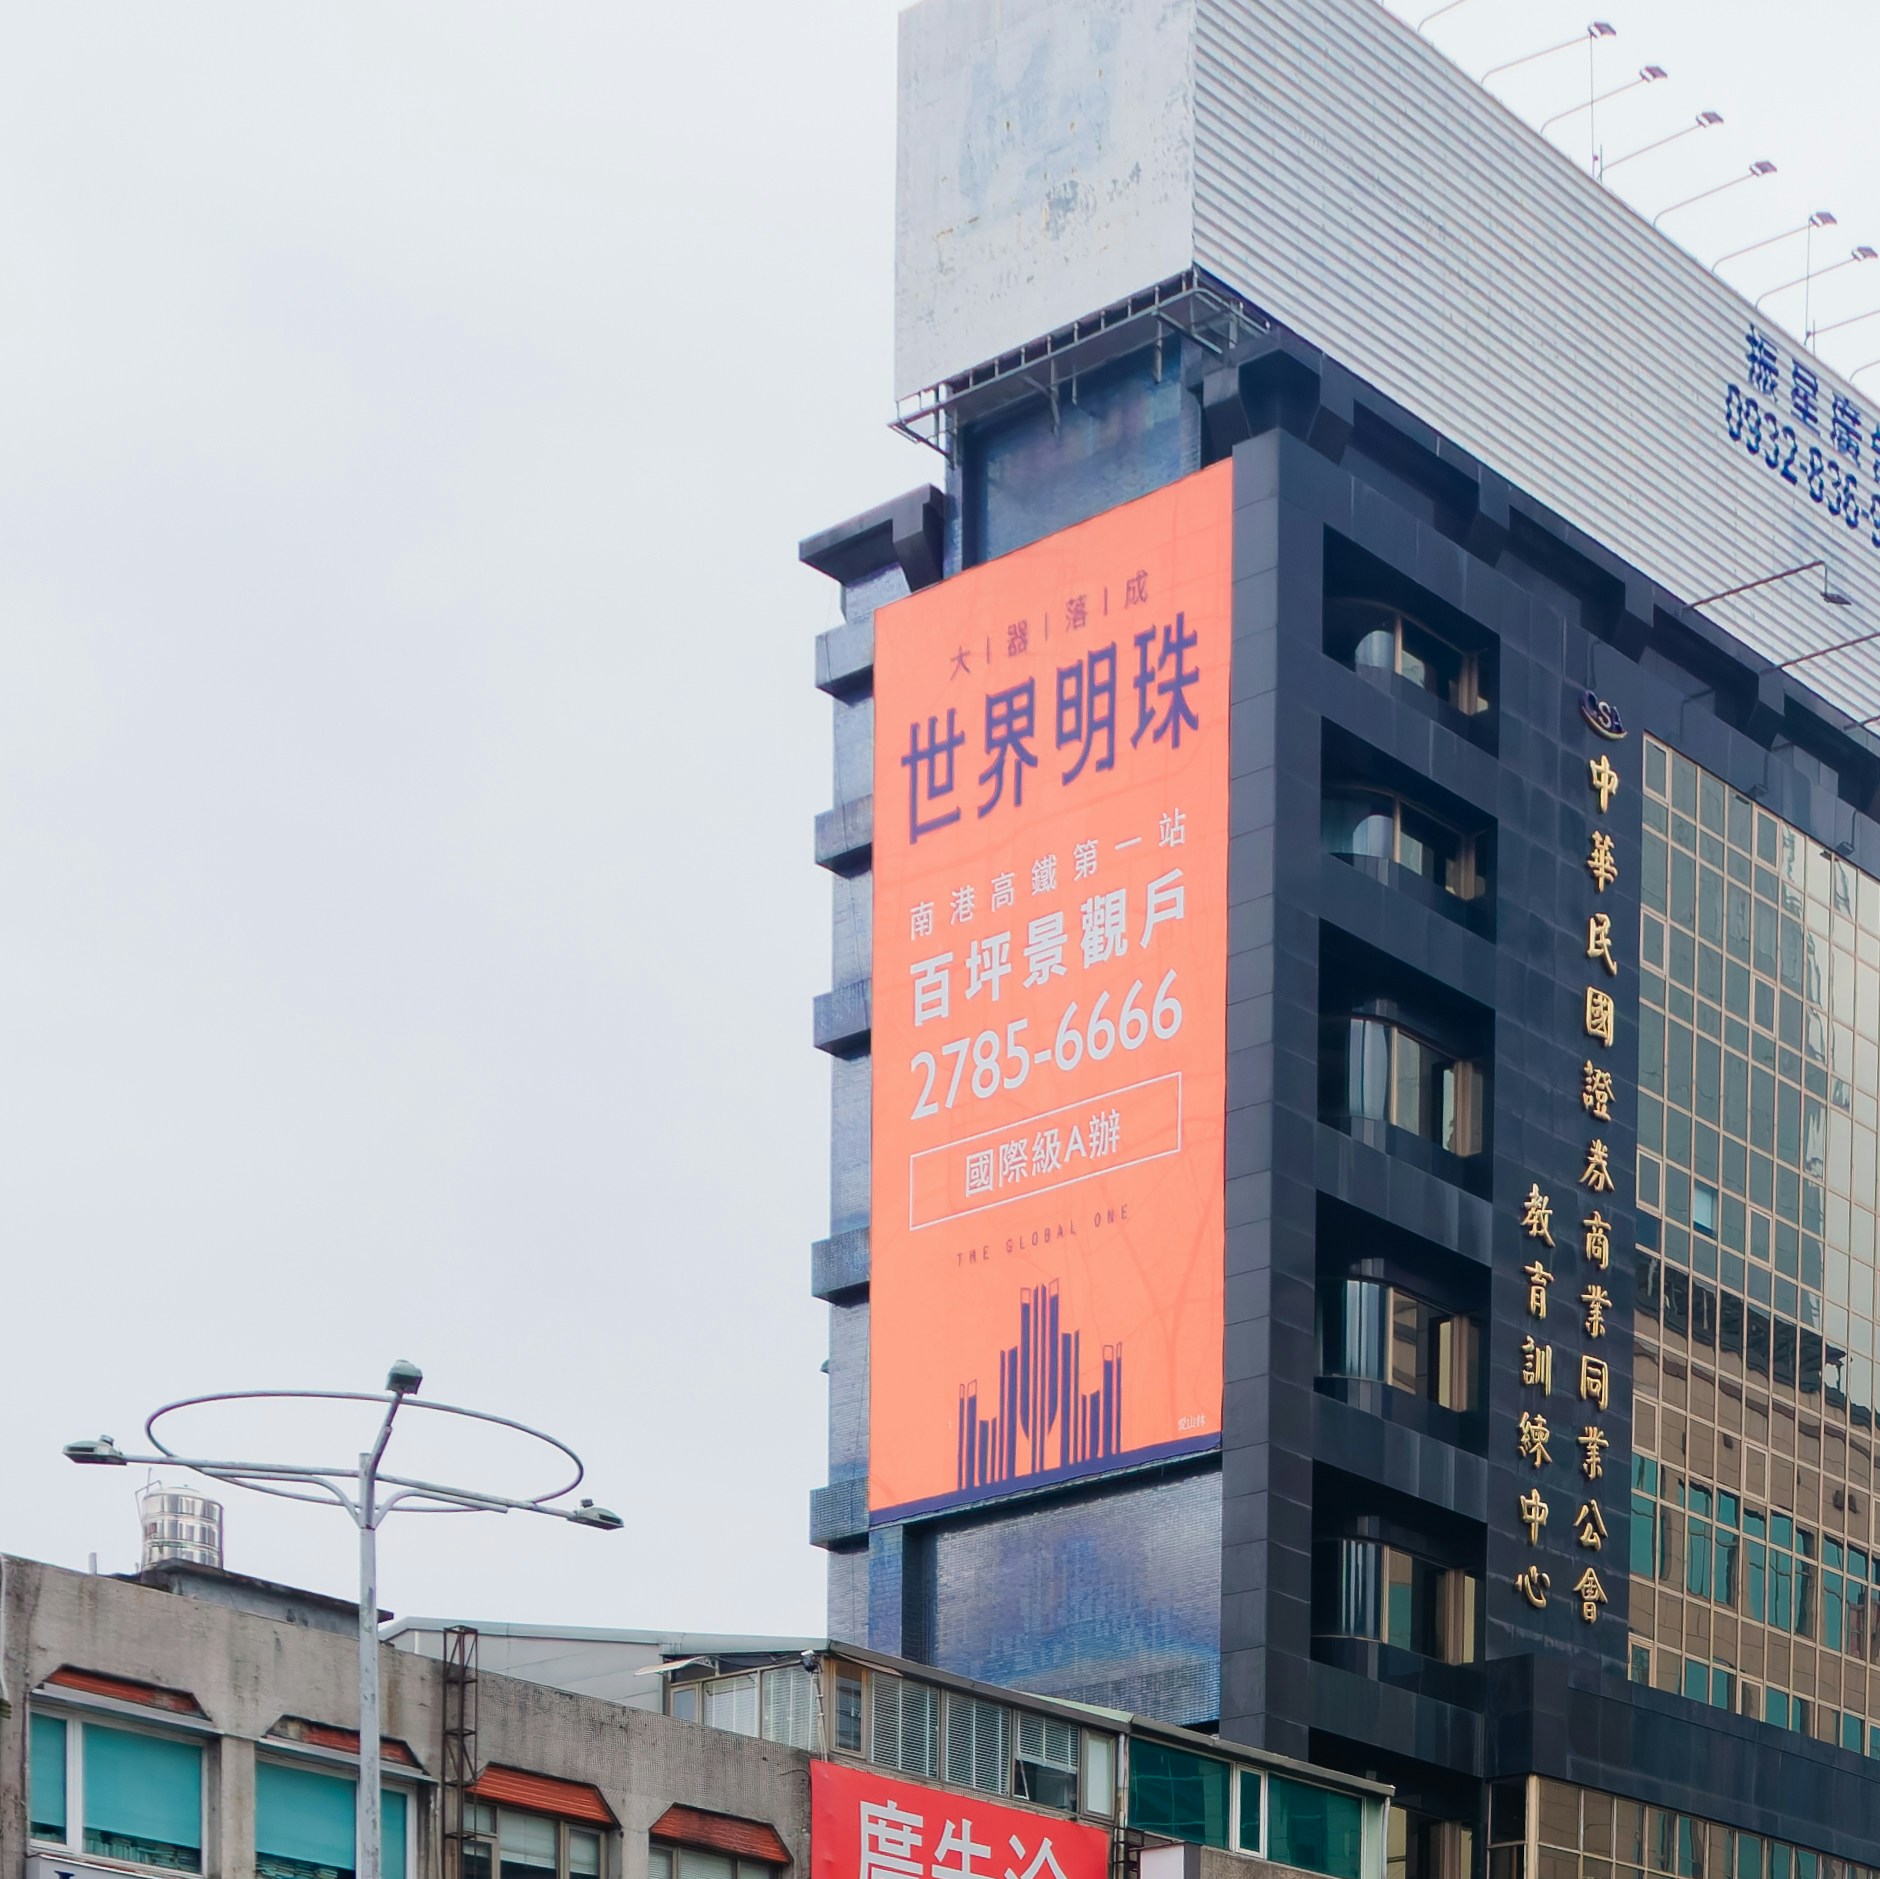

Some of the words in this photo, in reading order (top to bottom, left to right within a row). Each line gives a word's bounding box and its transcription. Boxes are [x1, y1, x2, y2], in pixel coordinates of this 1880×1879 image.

[901, 612, 1199, 843] 世界明珠
[1581, 690, 1626, 738] CSA
[910, 808, 1186, 939] 南港高鐵第一站
[910, 868, 1185, 1026] 百坪景觀戶
[910, 969, 1183, 1119] 2785-6666
[965, 1109, 1121, 1198] 國際級A辦
[1573, 755, 1619, 1624] 中華民國證券商業同業公會
[957, 1246, 991, 1267] THE
[1006, 1224, 1077, 1253] GLOBAL
[1094, 1204, 1129, 1228] ONE
[1514, 1183, 1555, 1608] 教育訓練中心
